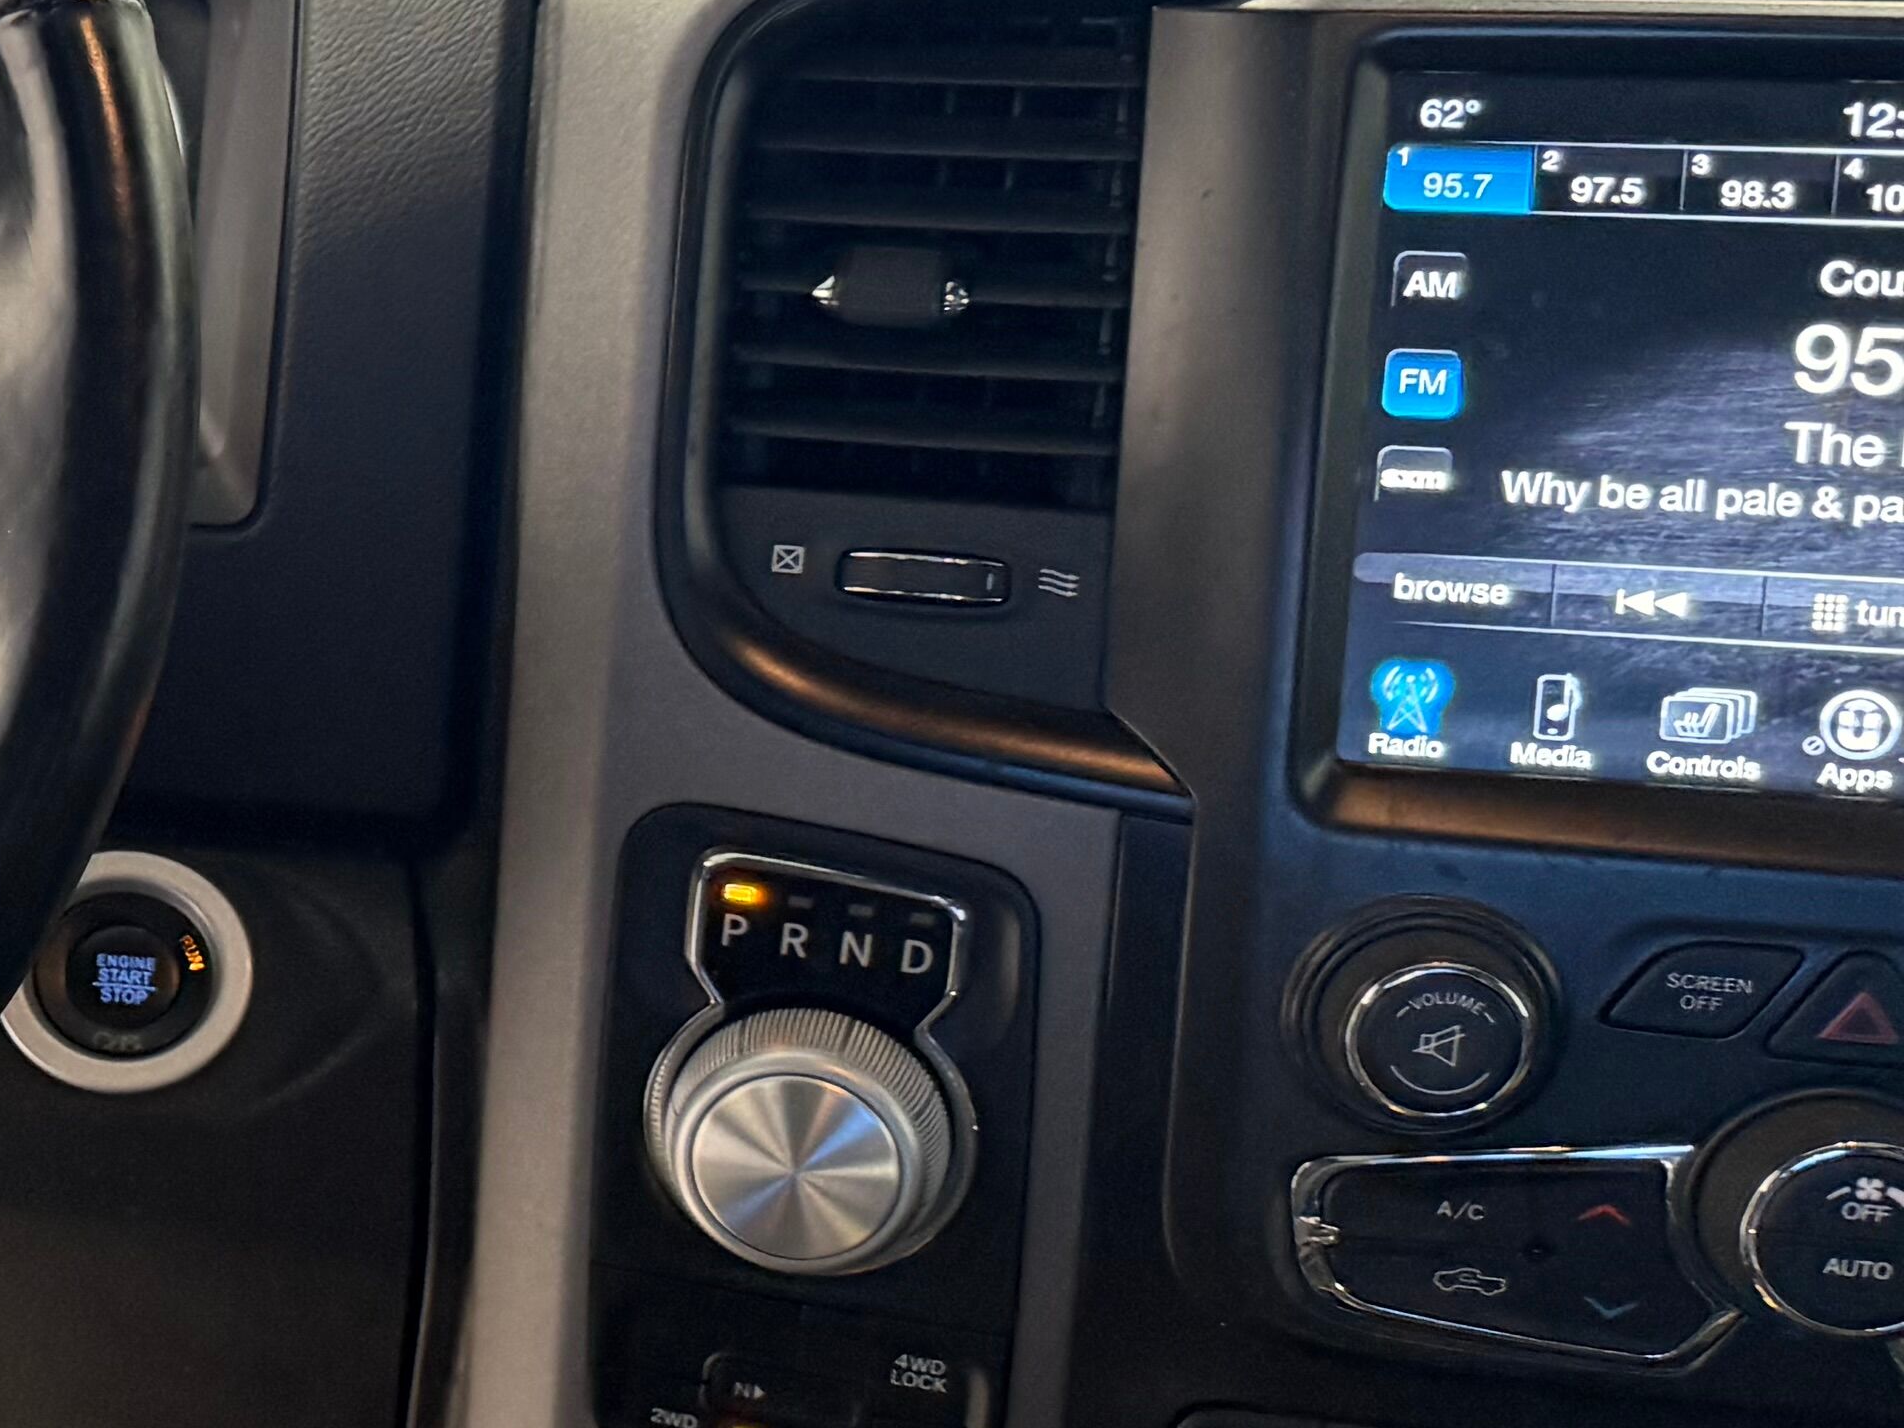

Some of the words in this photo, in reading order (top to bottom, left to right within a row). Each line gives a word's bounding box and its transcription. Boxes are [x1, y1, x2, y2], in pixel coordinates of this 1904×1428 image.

[1419, 97, 1483, 130] 62°
[1397, 146, 1411, 166] 1
[1541, 150, 1563, 172] 2
[1691, 153, 1712, 176] 3
[1843, 158, 1866, 180] 4
[1422, 172, 1494, 200] 95.7
[1570, 175, 1647, 206] 97.5
[1720, 179, 1796, 210] 98.3
[1402, 270, 1460, 299] AM
[1793, 323, 1904, 397] 95
[1398, 368, 1449, 396] FM
[1783, 421, 1887, 468] The
[1501, 469, 1592, 514] Why
[1598, 474, 1652, 511] be
[1658, 478, 1708, 513] all
[1714, 482, 1804, 522] pale
[1811, 485, 1845, 521] &
[1393, 572, 1512, 606] browse
[1367, 732, 1447, 759] Radio
[1509, 741, 1596, 770] Media
[1645, 750, 1763, 782] Controls
[1815, 762, 1894, 794] Apps
[720, 912, 750, 948] P
[779, 922, 810, 959] R
[838, 930, 874, 968] N
[899, 938, 935, 975] D
[95, 952, 157, 972] ENGINE
[97, 967, 154, 985] START
[1666, 972, 1753, 994] SCREEN
[99, 987, 149, 1005] STOP
[1407, 991, 1487, 1017] VOLUME
[1679, 994, 1723, 1011] OFF
[1436, 1199, 1485, 1221] A/C
[1841, 1201, 1894, 1223] OFF
[1822, 1257, 1894, 1280] AUTO
[894, 1353, 947, 1376] 4WD
[890, 1368, 948, 1393] LOCK
